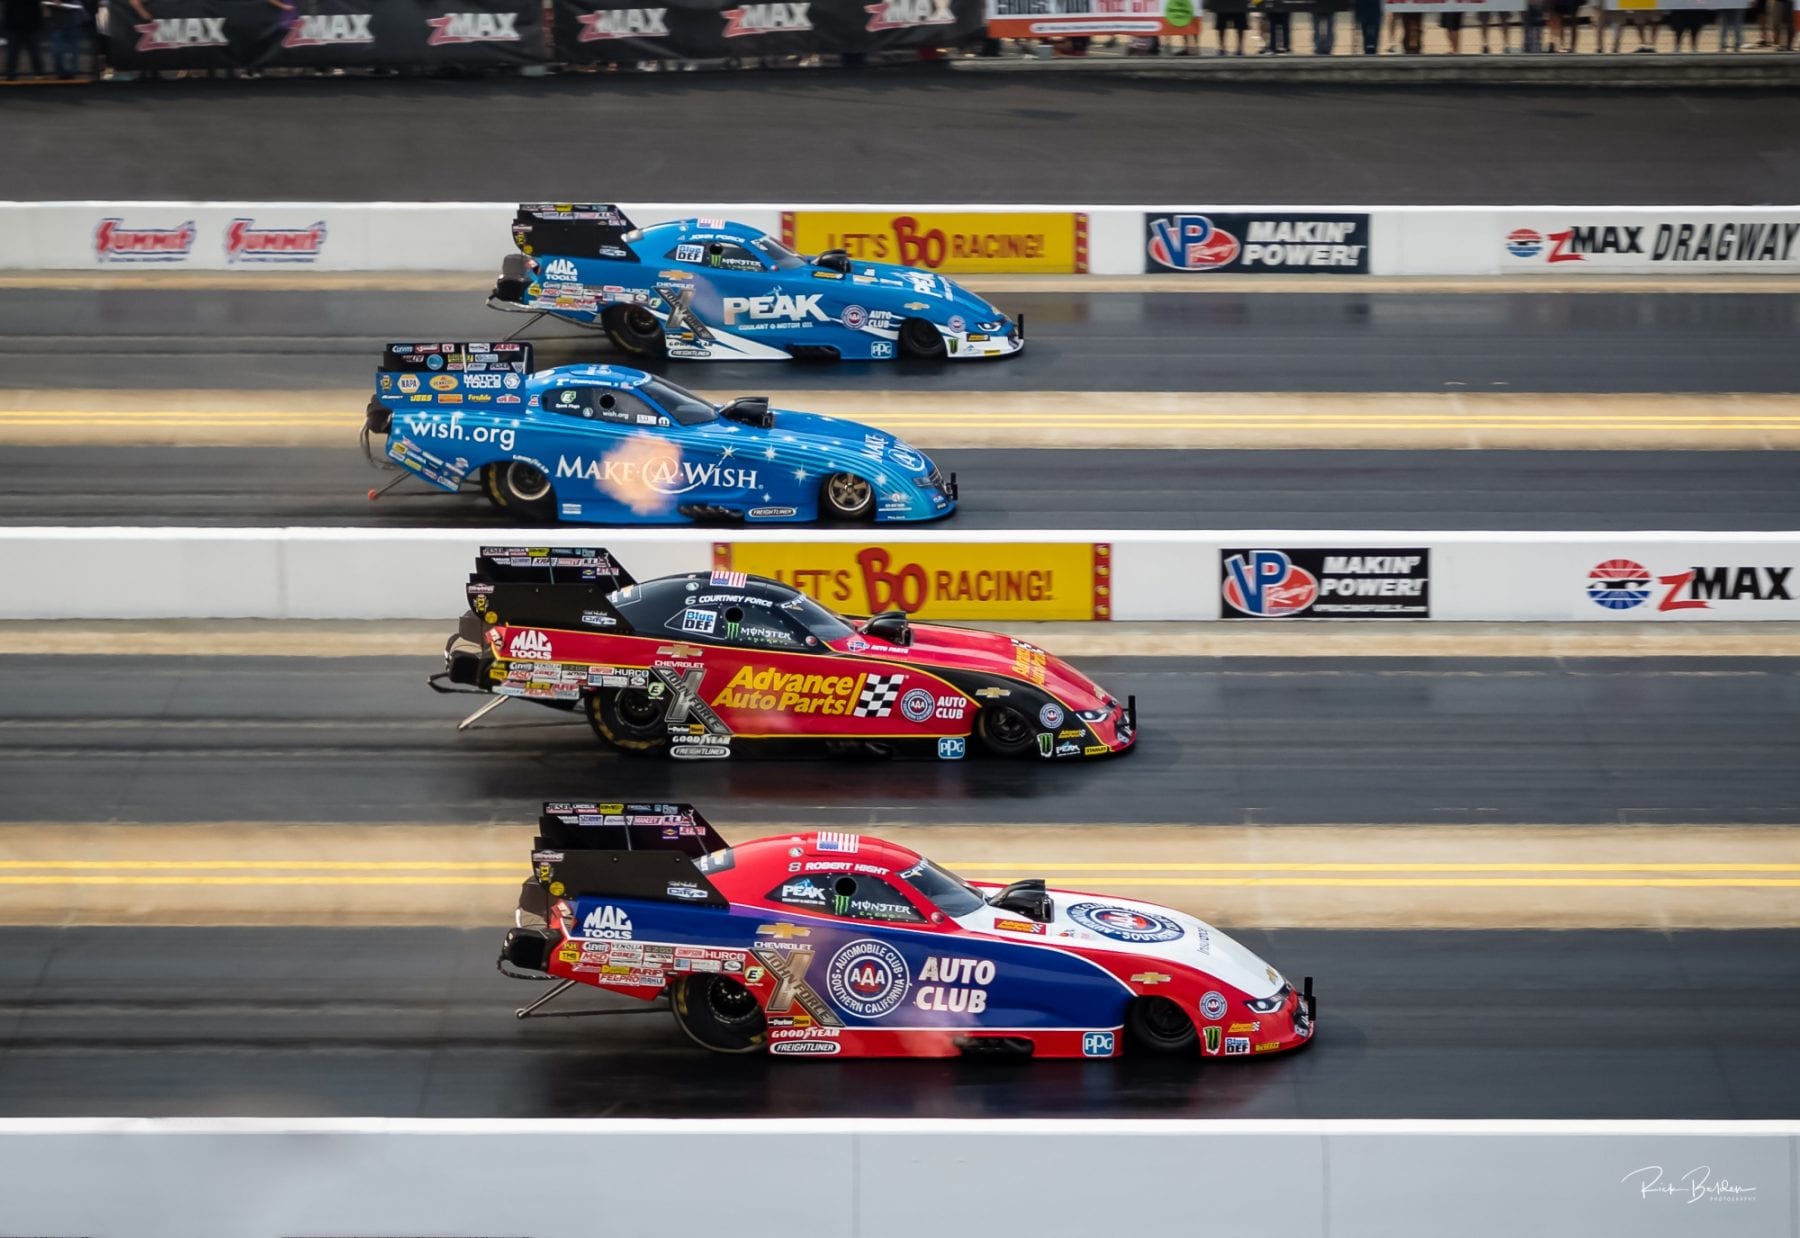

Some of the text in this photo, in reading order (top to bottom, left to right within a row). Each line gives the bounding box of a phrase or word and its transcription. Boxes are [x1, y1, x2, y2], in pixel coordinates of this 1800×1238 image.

[1247, 221, 1356, 243] MAKIN'
[953, 234, 1046, 258] RACING!
[1150, 214, 1214, 268] VP
[1650, 223, 1800, 261] DRAGWAY
[678, 252, 702, 261] DEF
[1241, 244, 1366, 266] POWER!
[545, 258, 578, 276] MAC
[545, 274, 578, 282] TOOLS
[723, 294, 832, 326] PEAK
[869, 310, 892, 320] AUTO
[867, 319, 891, 329] CLUB
[463, 374, 501, 382] MATCO
[603, 411, 629, 420] wish.org
[409, 419, 516, 451] wish.org
[555, 454, 637, 481] MAKE
[683, 460, 758, 490] WISH
[1322, 556, 1421, 574] MAKIN'
[936, 569, 1054, 601] RACING!
[1224, 550, 1292, 615] VP
[1319, 578, 1428, 597] POWER!
[685, 594, 774, 608] 6 COURTNEY FORCE
[687, 610, 714, 622] Blue
[685, 620, 713, 631] DEF
[509, 629, 553, 651] MAC
[740, 626, 792, 641] MONSTER
[510, 650, 552, 660] TOOLS
[655, 660, 705, 669] CHEVROLET
[614, 669, 650, 678] HURCO
[728, 666, 854, 695] Advance
[711, 687, 845, 715] Auto Parts
[937, 695, 967, 709] AUTO
[935, 707, 965, 720] CLUB
[672, 734, 731, 745] GOODYEAR
[788, 863, 801, 872] 8
[805, 862, 853, 871] ROBERT
[855, 863, 890, 876] HIGHT
[782, 885, 827, 900] PEAK
[851, 900, 912, 915] MONSTER
[583, 905, 633, 930] MAC
[583, 929, 633, 940] TOOLS
[753, 941, 813, 951] CHEVROLET
[581, 952, 608, 962] MSD
[705, 951, 746, 961] HURCO
[835, 943, 904, 974] AUTOMOBILE CLUB
[850, 967, 886, 987] AAA
[918, 956, 996, 986] AUTO
[831, 973, 905, 1014] SOUTHERN CALIFORNIA
[916, 986, 988, 1014] CLUB
[771, 1026, 841, 1039] GOODYEAR
[776, 1043, 834, 1052] FREIGHTLINER
[1084, 1034, 1113, 1054] PPG
[1226, 1045, 1249, 1053] DEF
